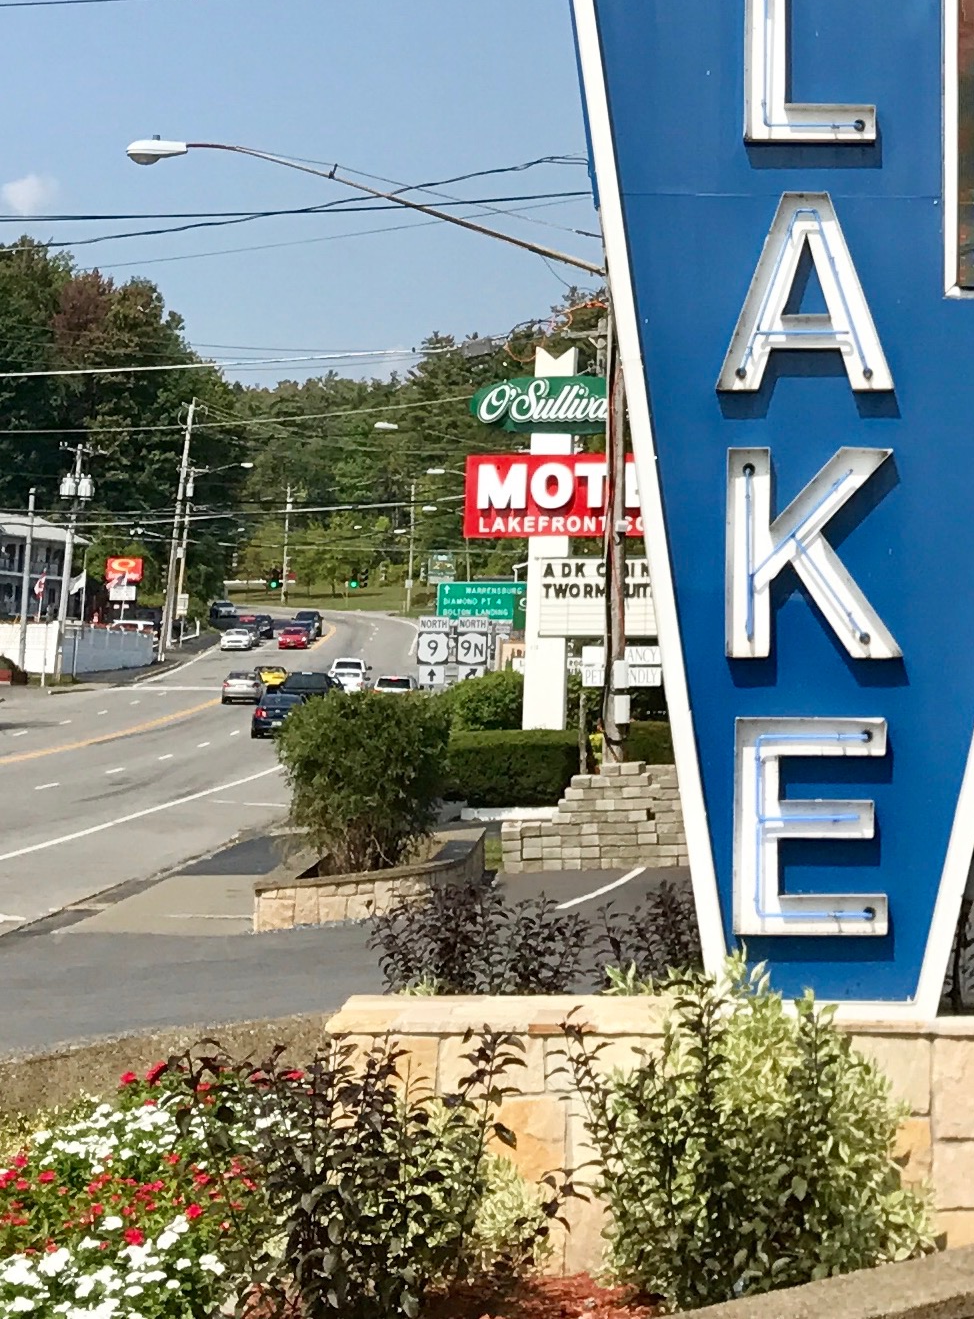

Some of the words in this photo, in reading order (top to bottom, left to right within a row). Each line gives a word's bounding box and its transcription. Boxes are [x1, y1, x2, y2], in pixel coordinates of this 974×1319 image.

[478, 379, 608, 421] O'Sulliva
[479, 515, 607, 533] LAKEFRONT
[543, 562, 586, 578] ADK
[443, 597, 478, 605] DIAMOND
[481, 597, 491, 605] PT
[420, 619, 448, 629] NORTH
[459, 619, 487, 629] NORTH
[427, 639, 439, 657] 9
[460, 639, 484, 658] 9N
